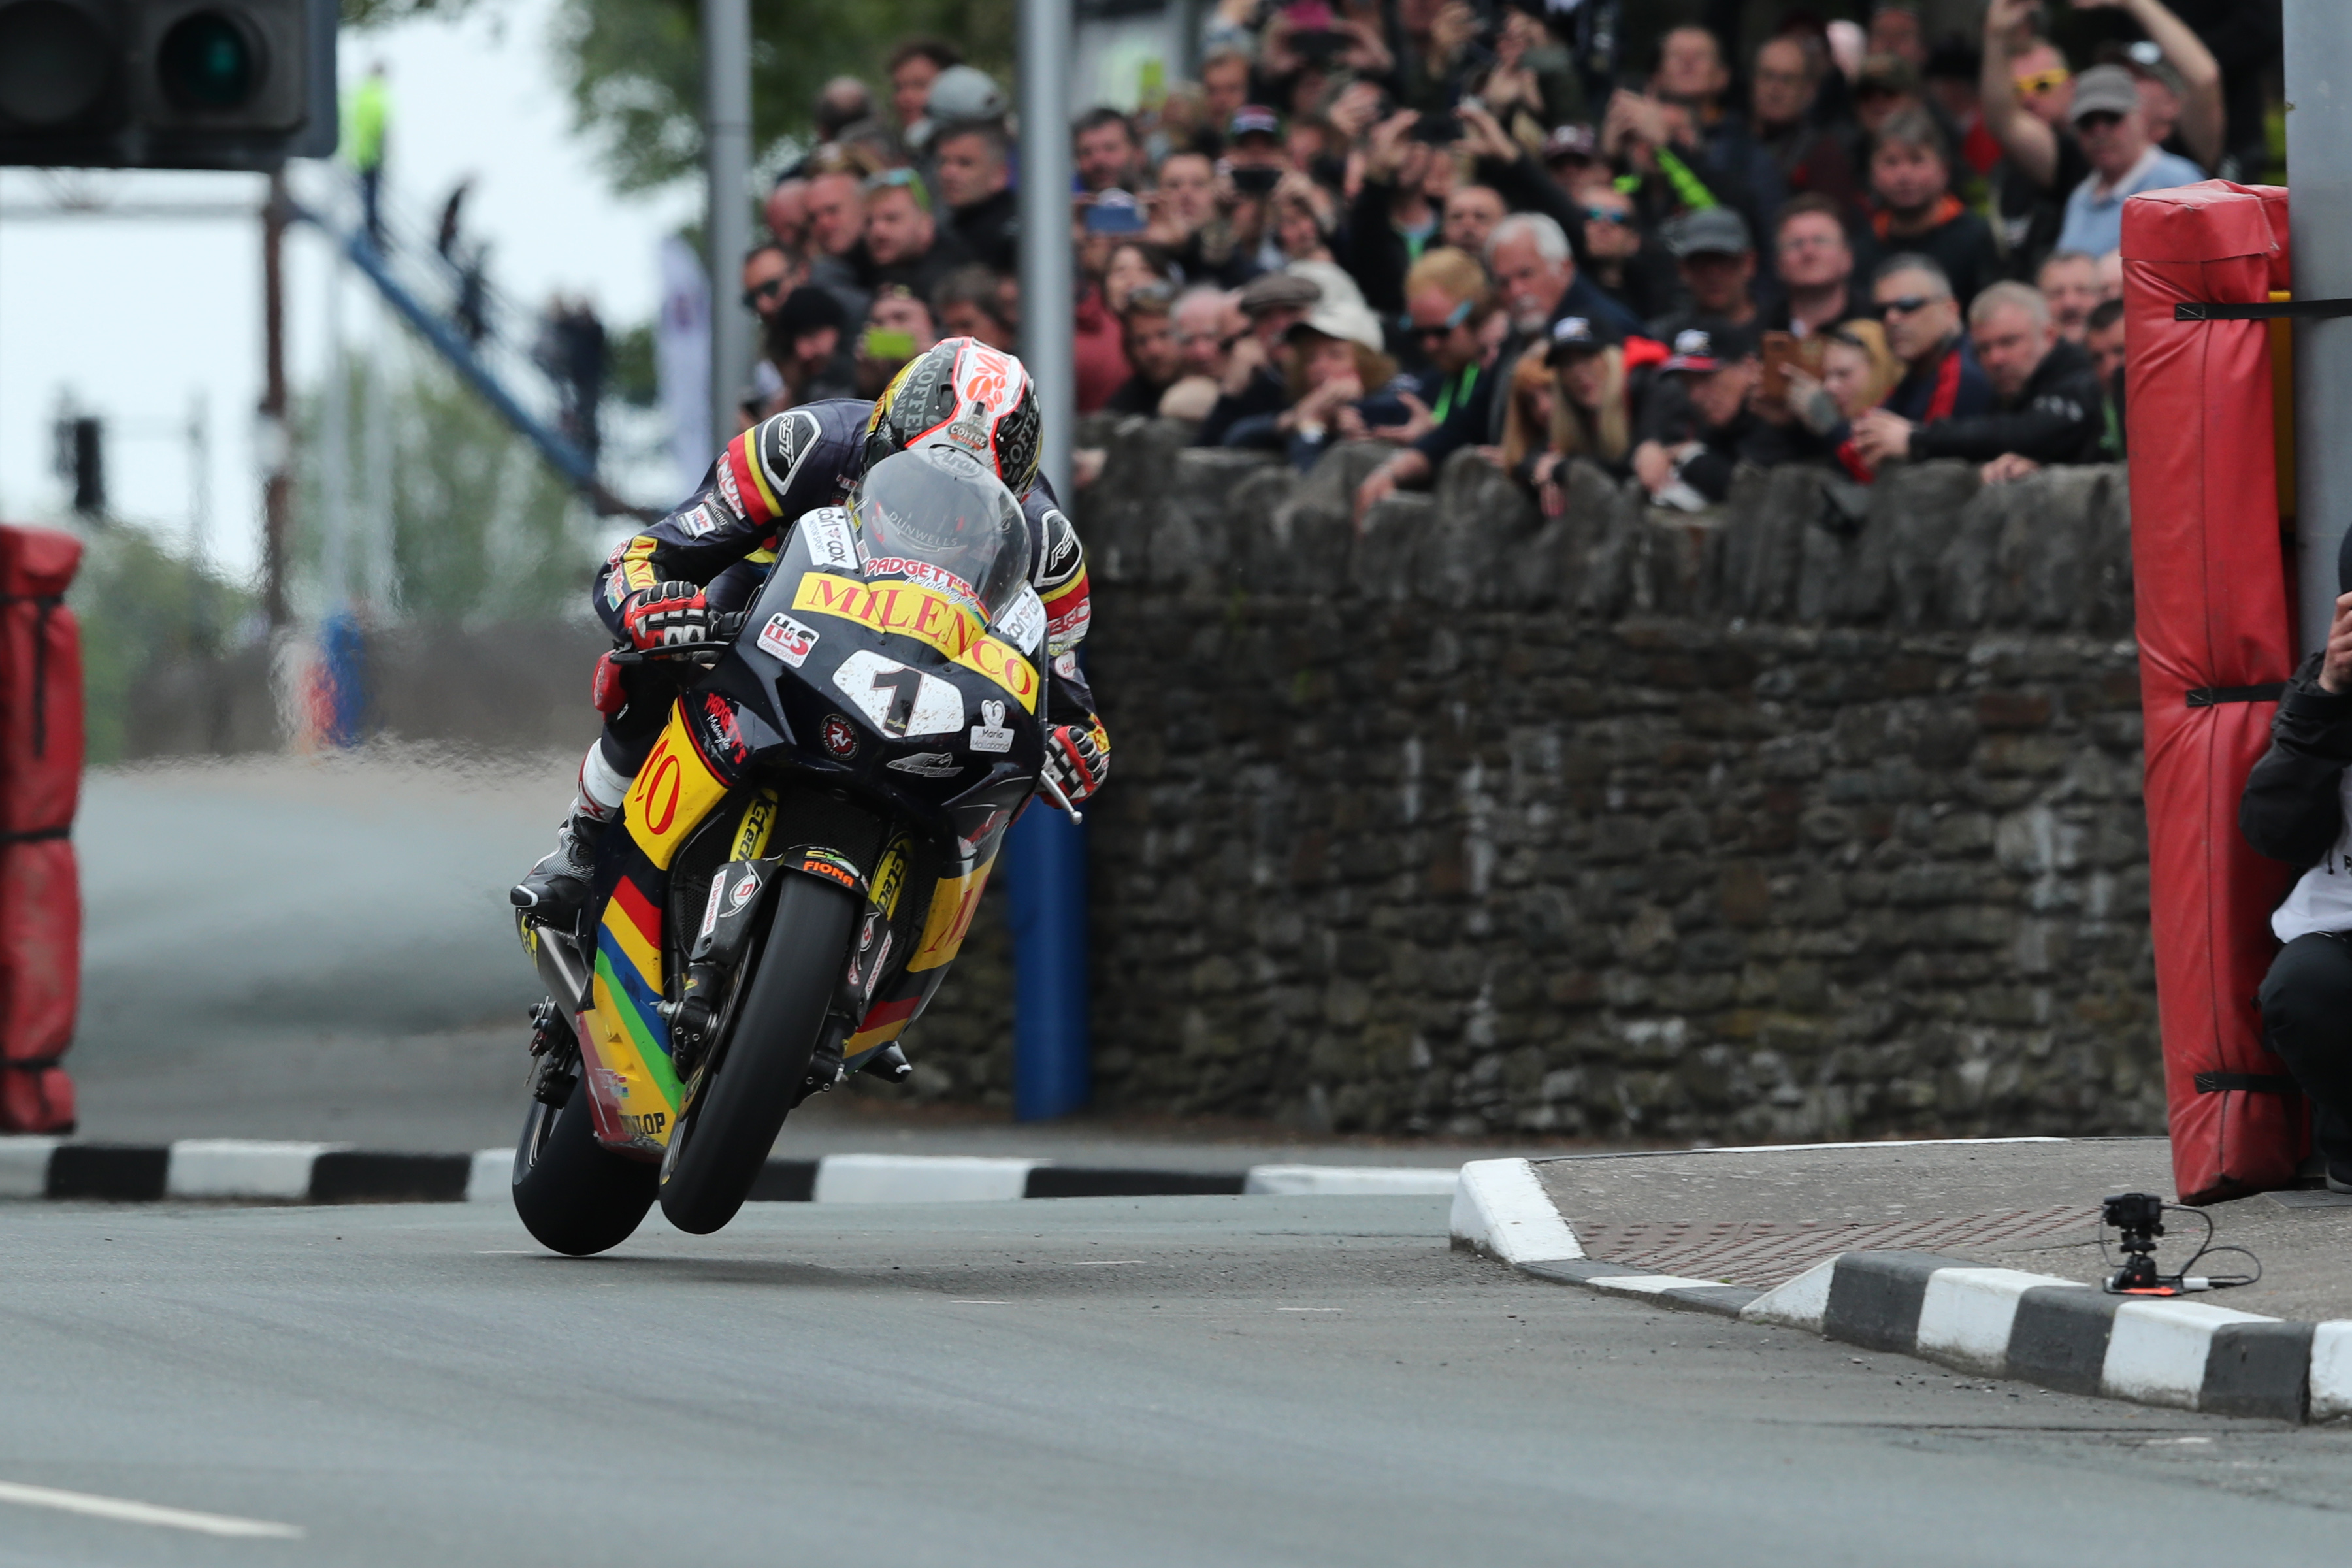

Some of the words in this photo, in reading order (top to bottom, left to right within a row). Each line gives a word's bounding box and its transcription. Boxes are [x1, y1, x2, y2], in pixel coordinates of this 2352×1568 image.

[888, 511, 958, 546] DUNWELLS
[826, 540, 847, 563] cox
[866, 557, 972, 597] PADGETT'S
[807, 578, 1031, 696] MILENCO
[871, 667, 924, 736] 1
[704, 692, 747, 764] PADGETT'S
[802, 860, 855, 887] FIONA
[705, 887, 721, 932] brembo
